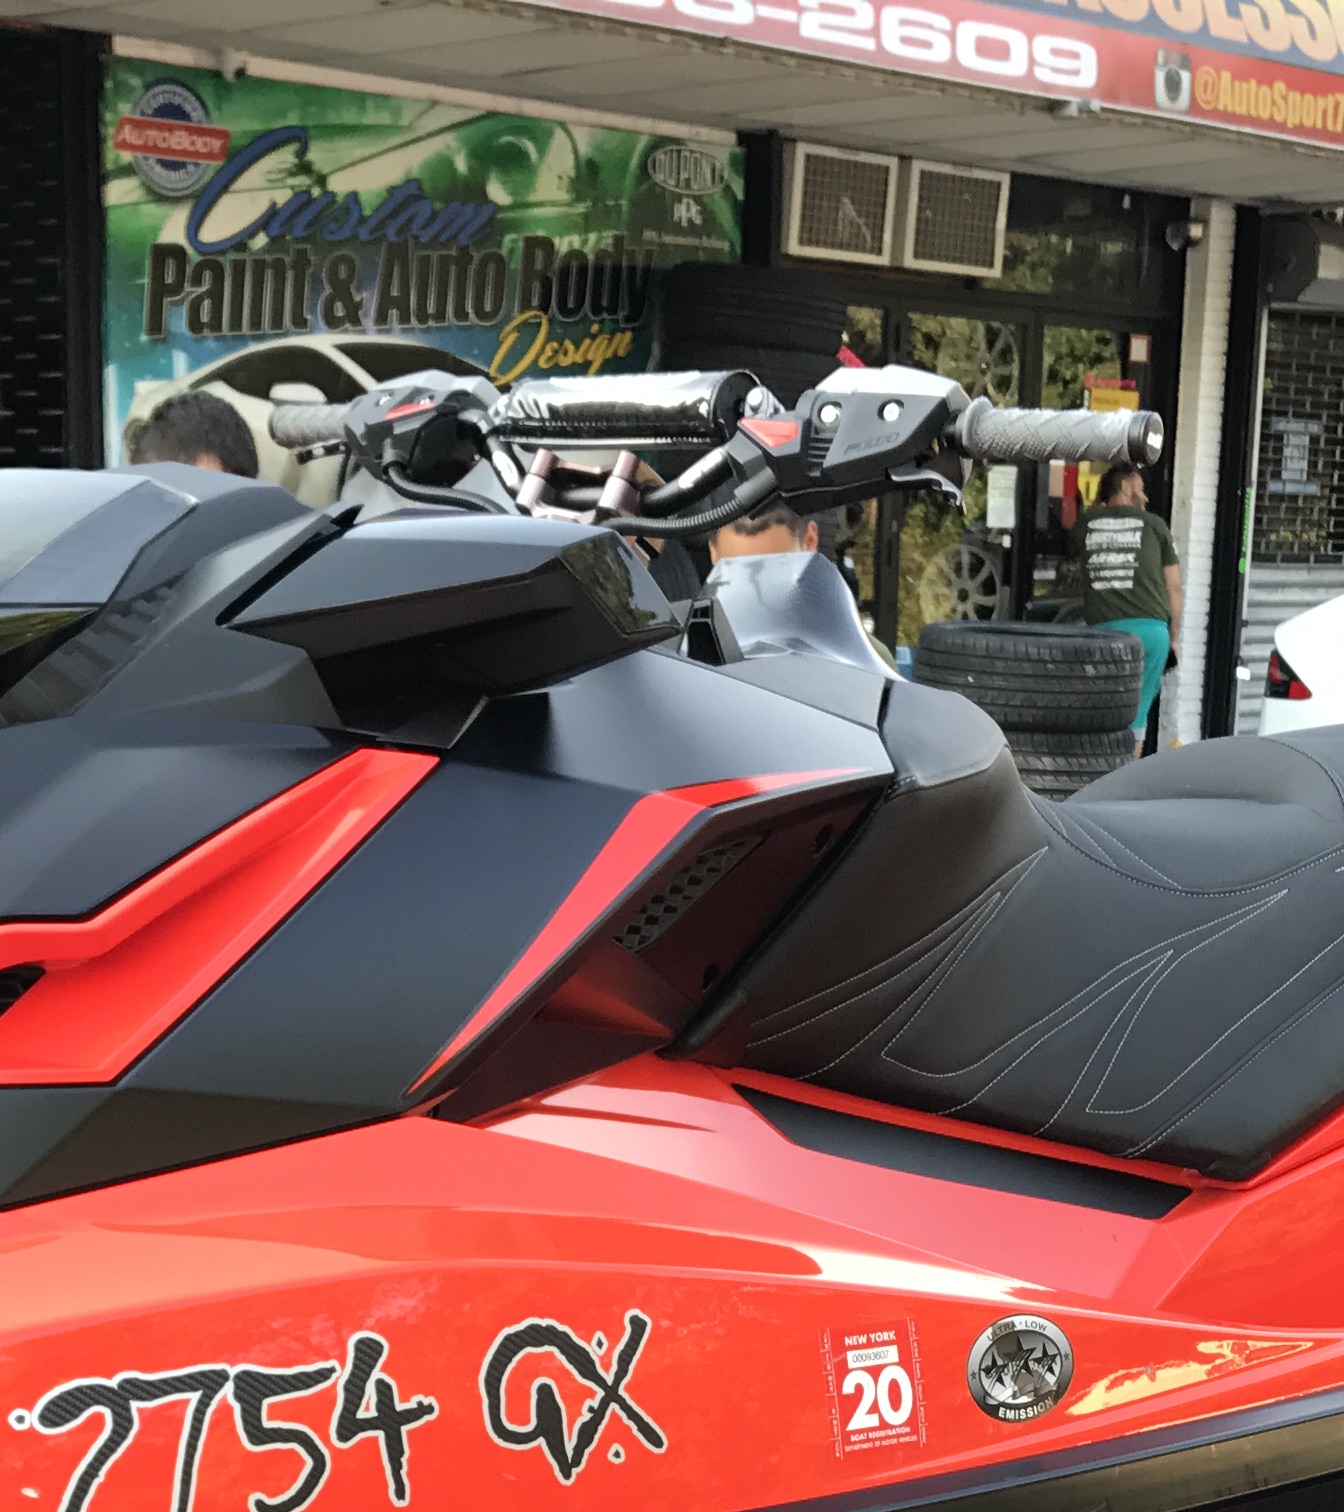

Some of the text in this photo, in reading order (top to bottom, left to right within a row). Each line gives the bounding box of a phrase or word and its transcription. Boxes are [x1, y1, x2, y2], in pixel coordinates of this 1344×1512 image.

[186, 126, 497, 254] Custom
[144, 234, 658, 341] Paint & Auto Body
[488, 309, 635, 386] Design
[844, 1330, 897, 1347] NEW YORK
[986, 1320, 1048, 1342] ULTRA LOW
[842, 1365, 913, 1431] 20
[998, 1396, 1054, 1420] EMISSION
